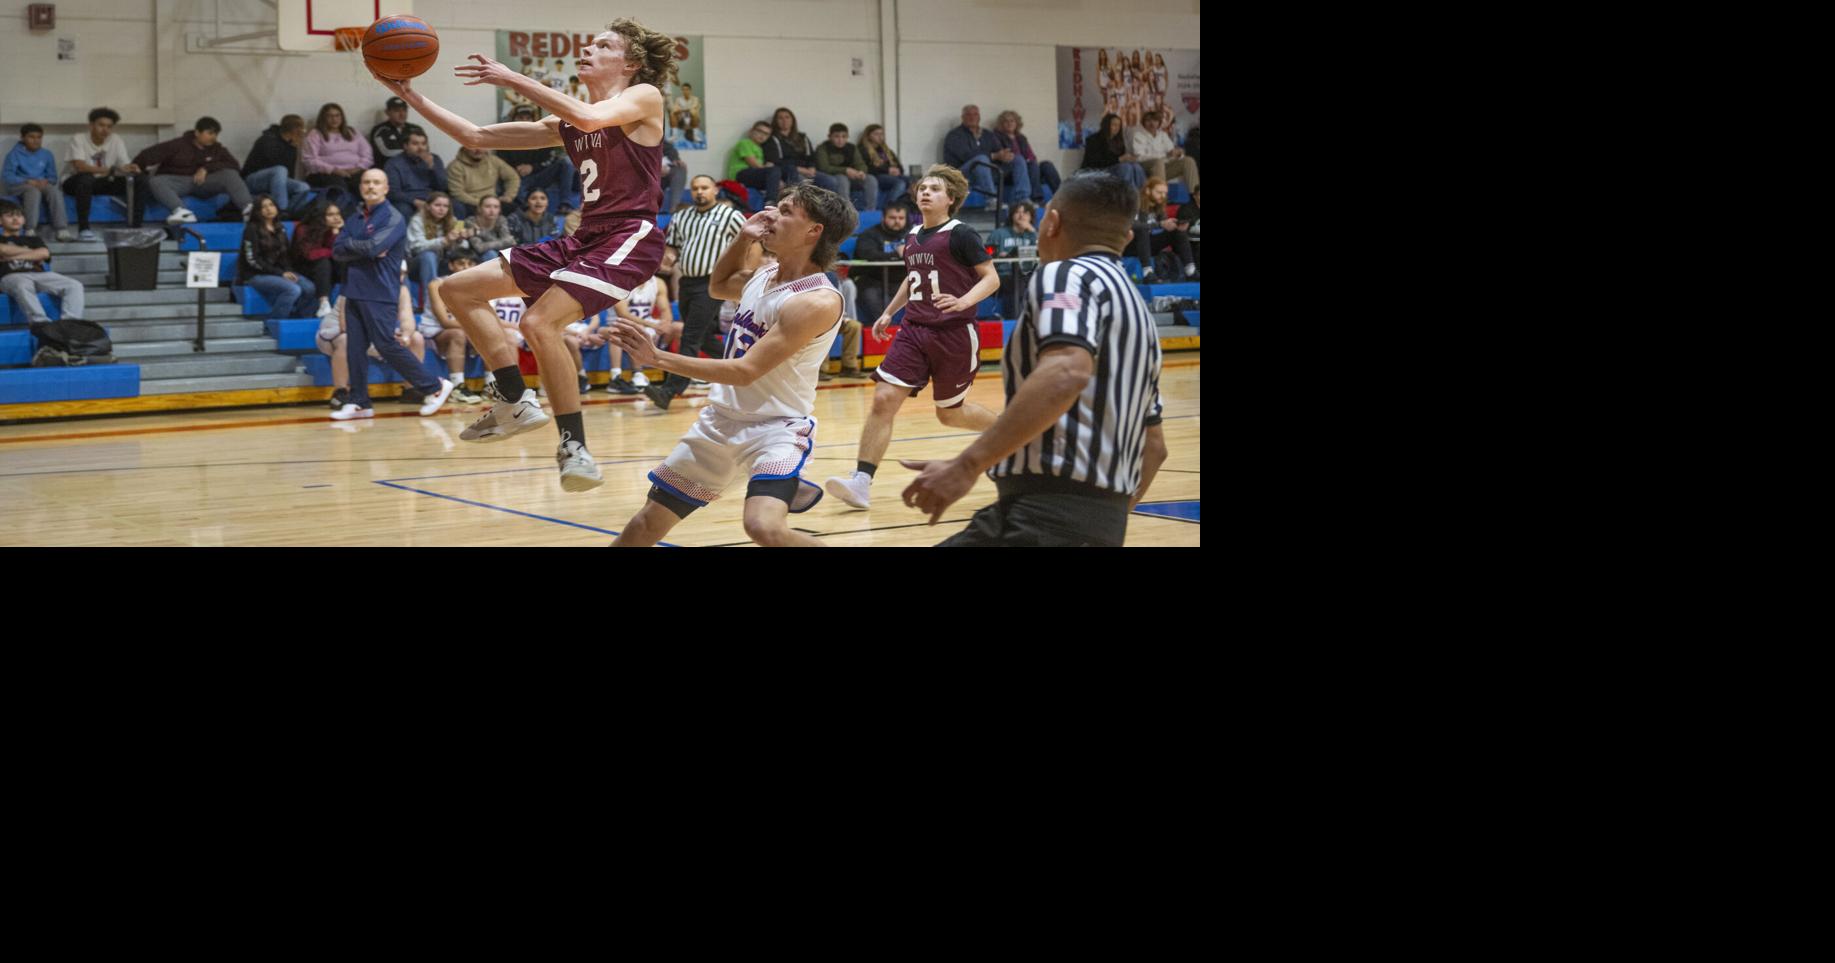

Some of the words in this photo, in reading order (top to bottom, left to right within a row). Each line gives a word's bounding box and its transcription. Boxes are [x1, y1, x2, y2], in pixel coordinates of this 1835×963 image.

[508, 31, 688, 60] REDHS
[579, 158, 601, 202] 2
[908, 252, 934, 266] WWVA
[907, 269, 940, 301] 21
